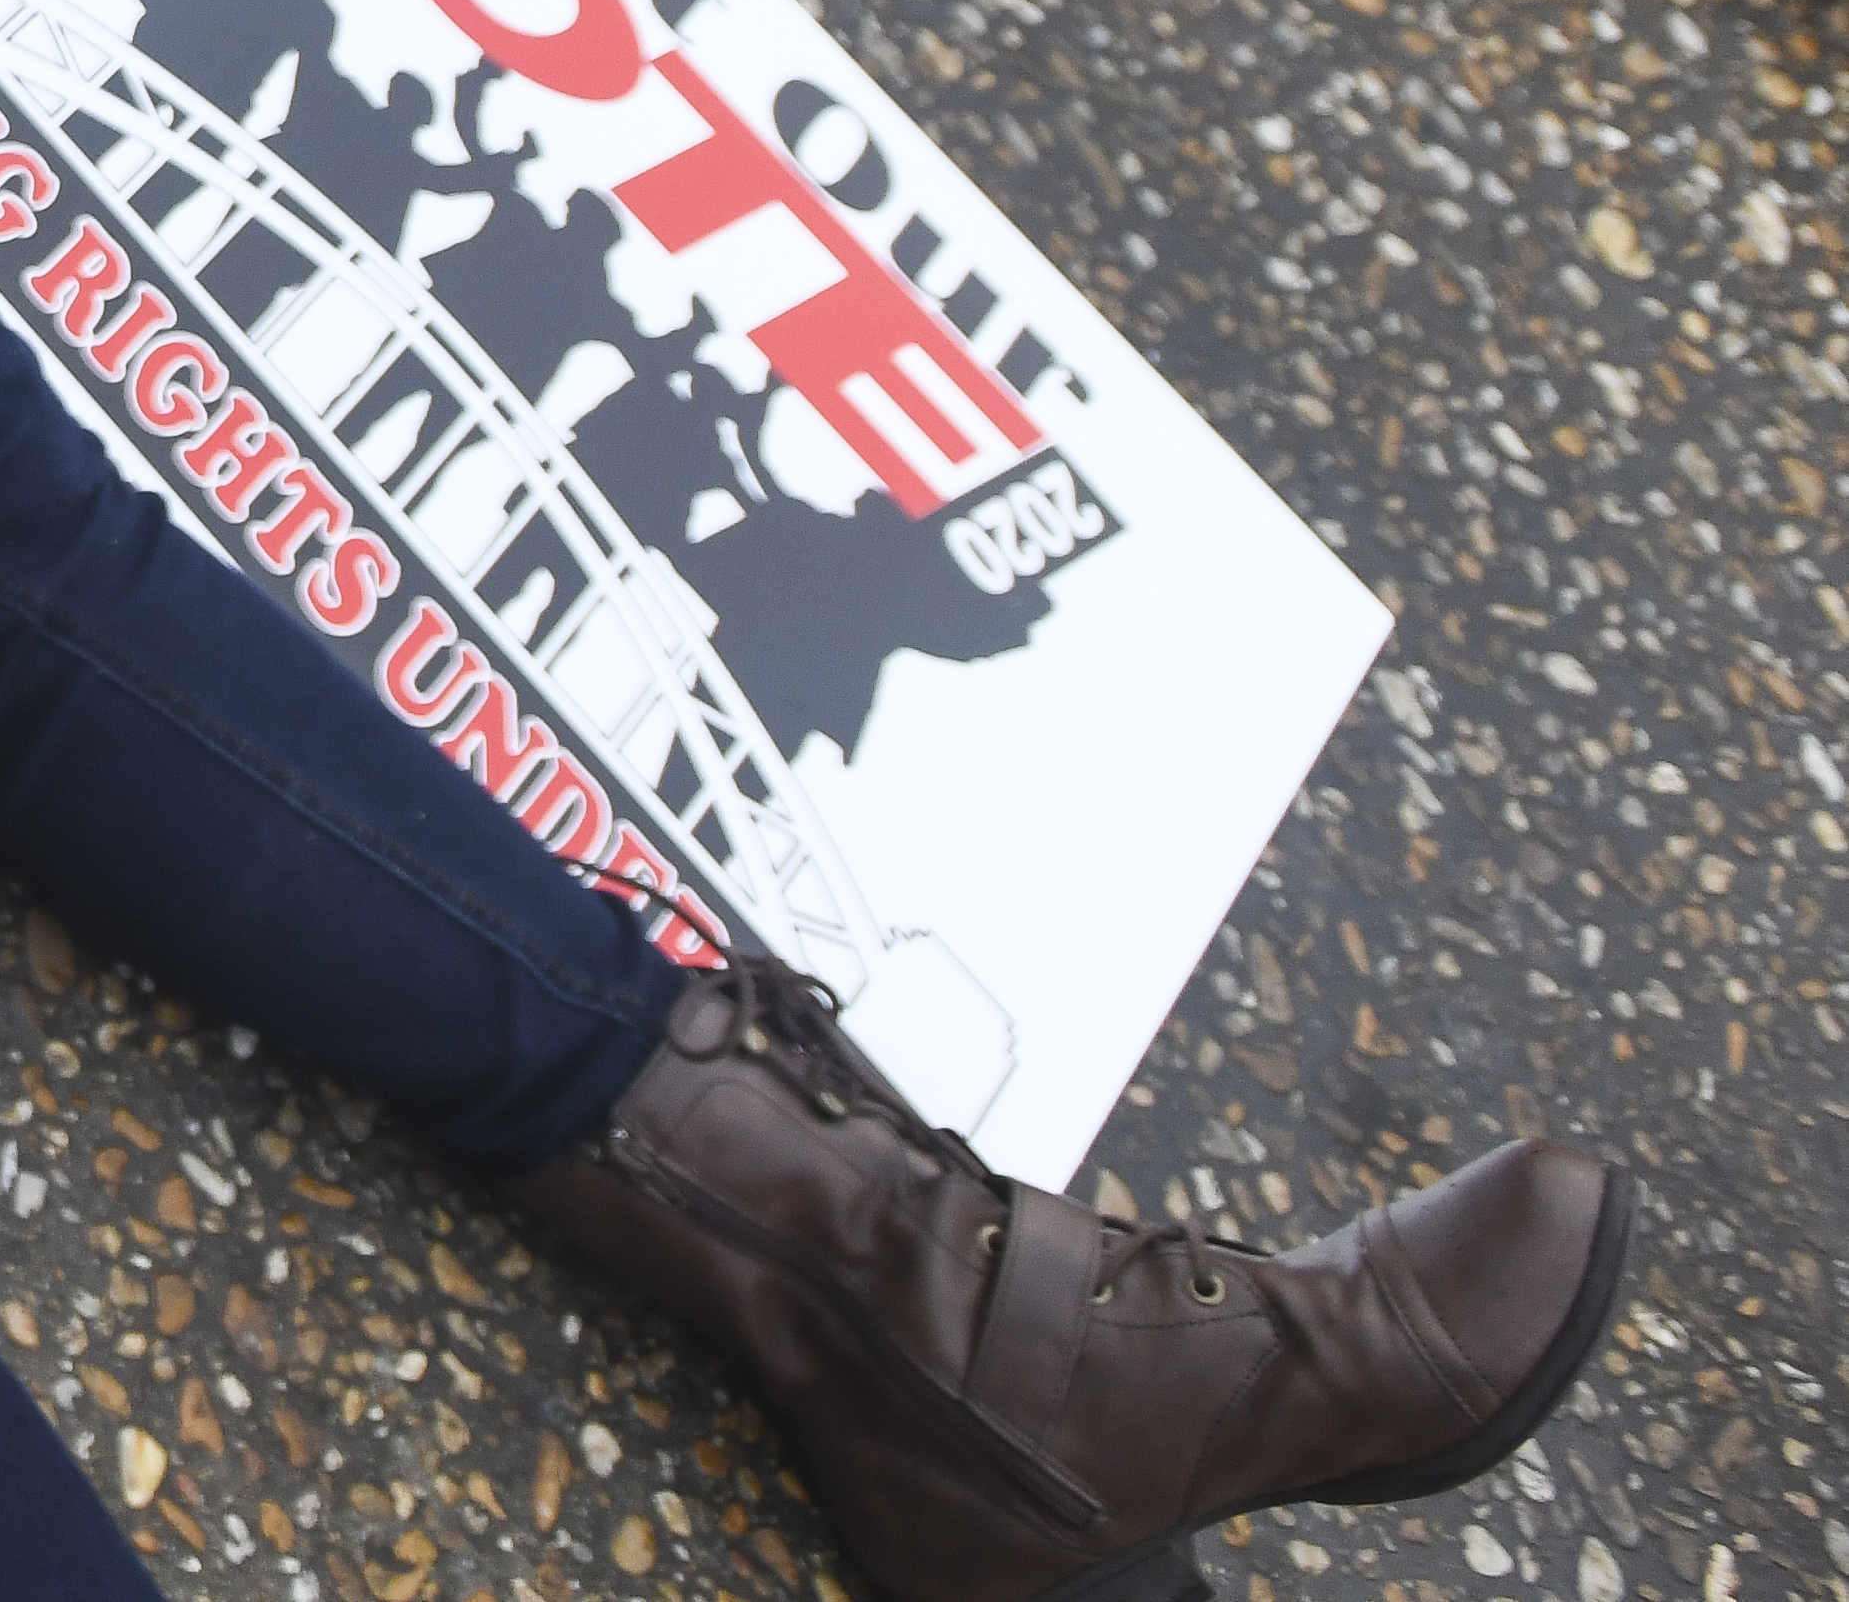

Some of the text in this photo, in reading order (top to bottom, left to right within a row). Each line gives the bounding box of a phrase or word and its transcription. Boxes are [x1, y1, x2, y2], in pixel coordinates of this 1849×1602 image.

[772, 76, 1096, 405] Our
[25, 213, 406, 639] RIGHTS
[943, 457, 1108, 594] 2020
